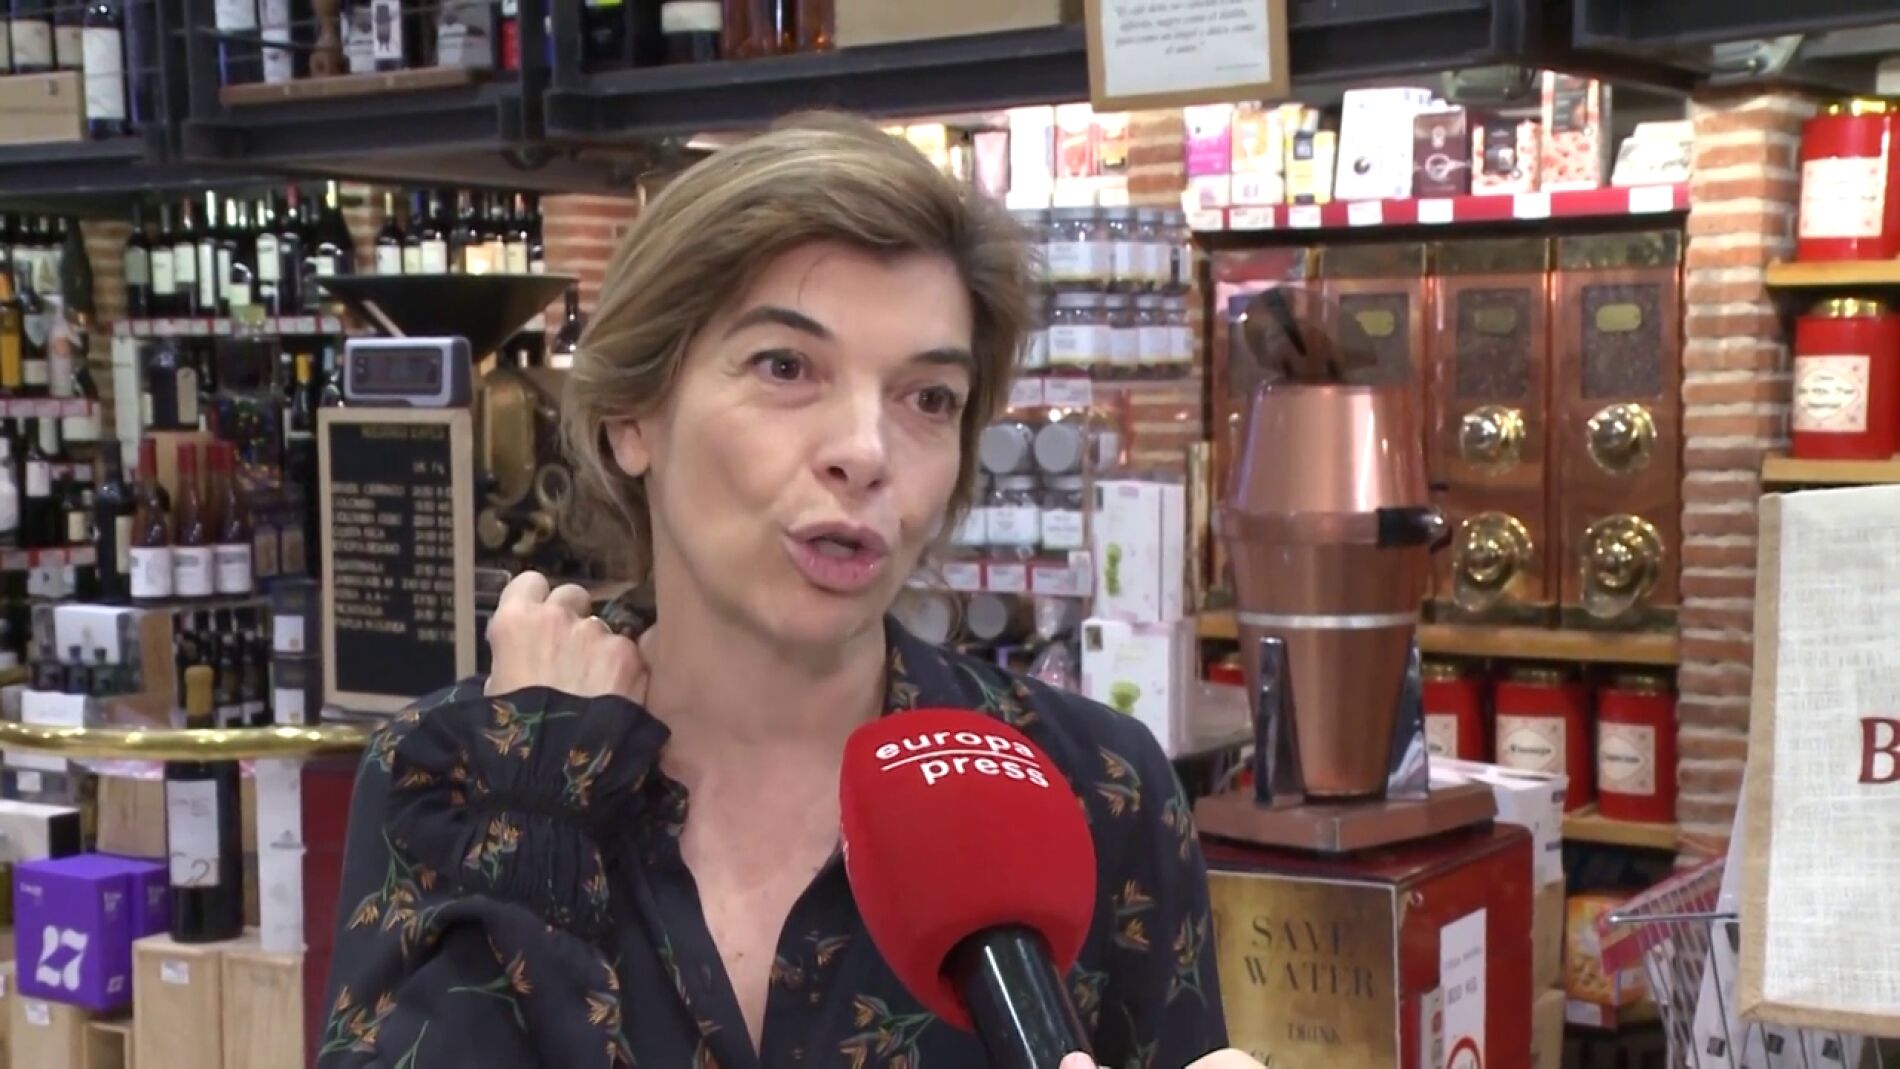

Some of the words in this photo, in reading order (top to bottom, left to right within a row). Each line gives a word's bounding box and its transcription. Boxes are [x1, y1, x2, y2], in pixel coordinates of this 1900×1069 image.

[875, 730, 1035, 759] europa
[919, 756, 1049, 788] press
[1251, 914, 1352, 957] SAVE
[1244, 955, 1375, 999] WATER
